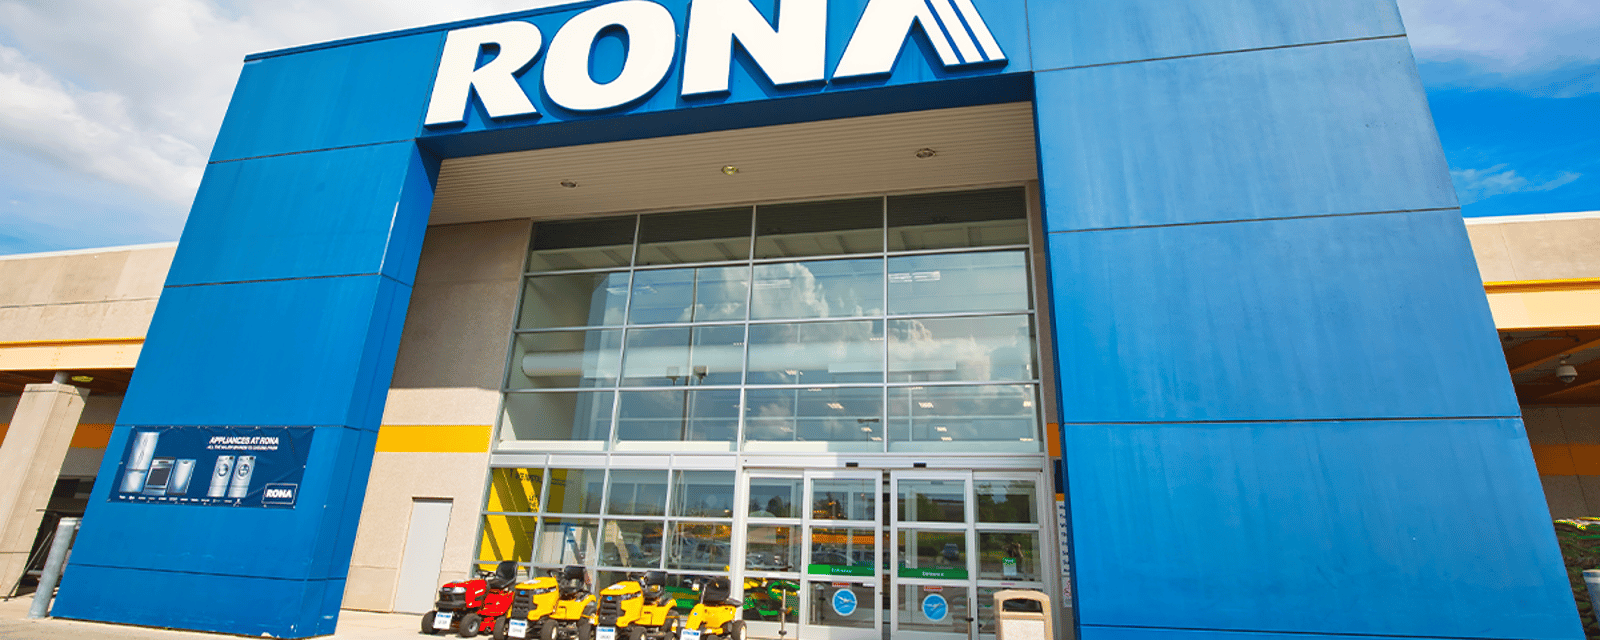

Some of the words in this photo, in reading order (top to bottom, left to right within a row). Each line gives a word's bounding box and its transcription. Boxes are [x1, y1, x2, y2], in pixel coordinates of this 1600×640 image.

[424, 0, 1008, 128] RONA
[209, 436, 251, 445] APPLIANCES
[251, 436, 260, 445] AT
[260, 436, 279, 445] RONA
[266, 489, 292, 498] RONA
